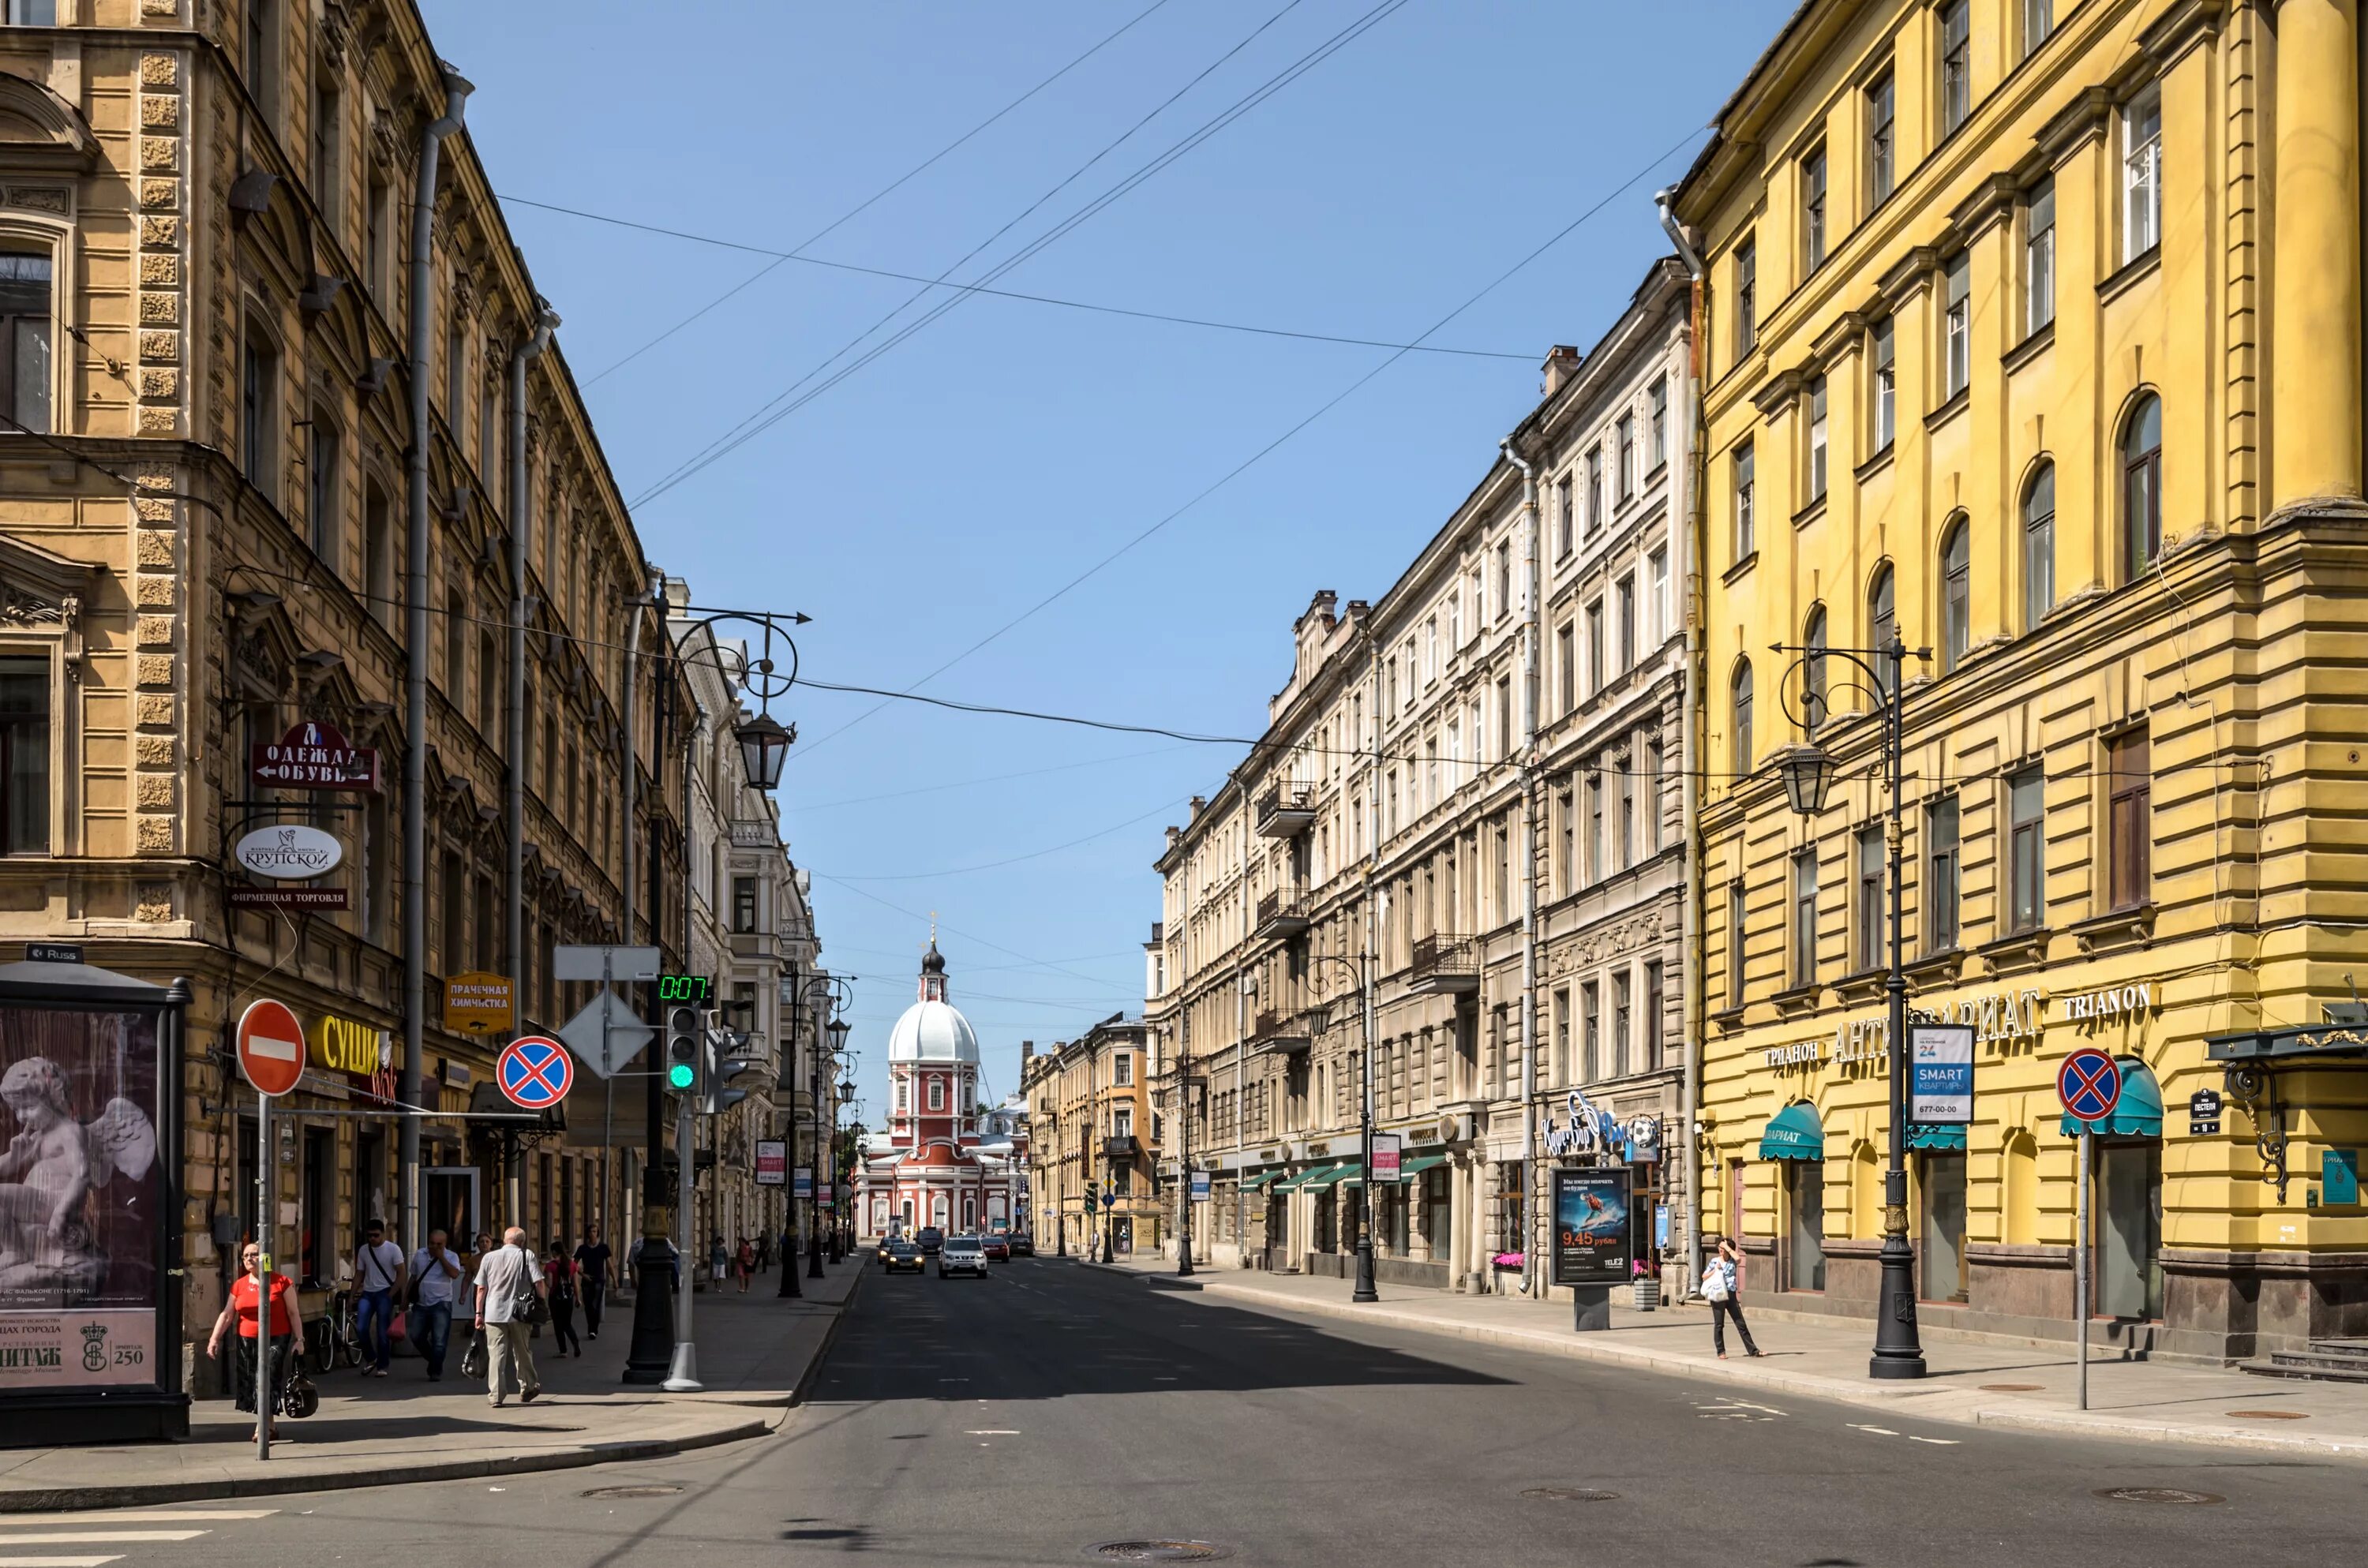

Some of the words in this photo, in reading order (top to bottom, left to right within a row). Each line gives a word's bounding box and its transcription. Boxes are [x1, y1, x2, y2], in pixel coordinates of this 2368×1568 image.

[279, 764, 346, 783] ОБУВЬ
[245, 850, 328, 869] КРУПСКОЙ
[232, 893, 291, 902] ФИРМЕННАЯ
[295, 893, 344, 903] ТОРГОВЛЯ
[47, 949, 77, 960] Russ
[451, 985, 508, 994] ПРАЧЕЧНАЯ
[660, 976, 706, 999] 0:07
[451, 997, 508, 1008] ХИМЧИСТКА
[2063, 982, 2151, 1020] TRIANON
[324, 1015, 379, 1076] СУШИ
[1920, 1045, 1936, 1057] 24
[1765, 1042, 1819, 1067] ТРИАНОН
[1920, 1069, 1963, 1080] SMART
[2195, 1102, 2216, 1111] ПЕСТЕЛЯ
[2202, 1124, 2207, 1132] 10
[1563, 1231, 1593, 1246] 9,45
[1594, 1237, 1617, 1246] рубля
[114, 1350, 144, 1366] 250
